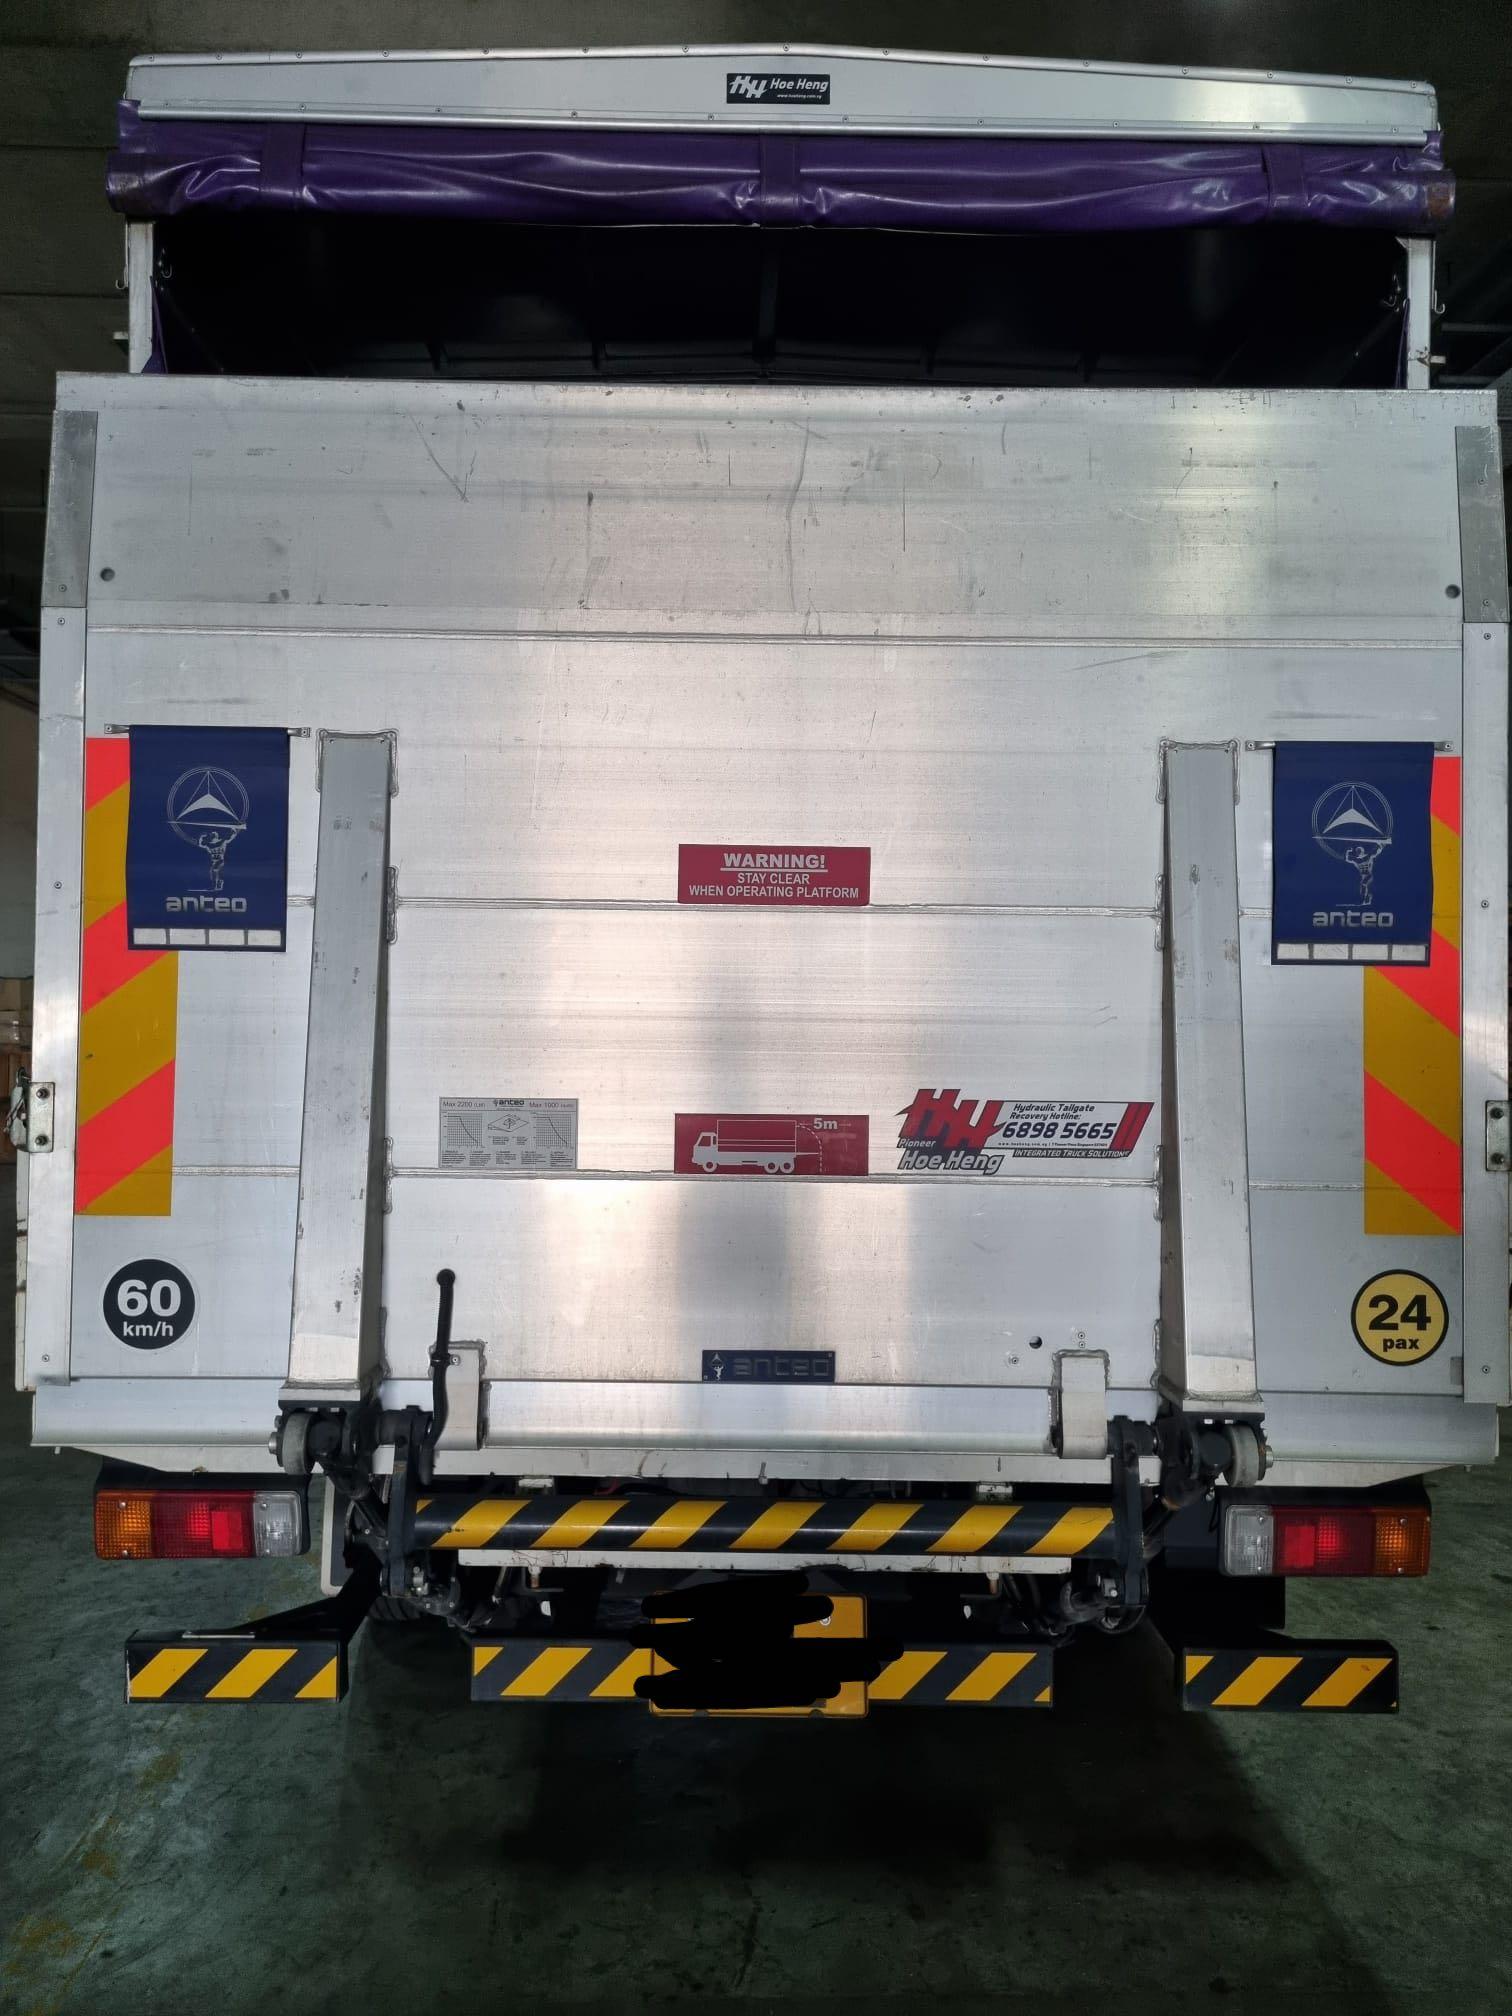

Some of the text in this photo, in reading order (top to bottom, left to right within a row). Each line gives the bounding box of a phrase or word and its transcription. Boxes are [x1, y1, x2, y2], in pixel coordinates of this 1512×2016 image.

[770, 78, 829, 93] Hoe Heng
[723, 853, 826, 869] WARNING!
[737, 872, 810, 885] STAY CLEAR
[689, 885, 859, 899] WHEN OPERATING PLATFORM
[166, 895, 247, 912] anteo
[1312, 910, 1394, 927] anteo
[1013, 1103, 1095, 1113] Hydraulic Tailgate
[813, 1118, 838, 1130] 5m
[1010, 1112, 1048, 1121] Recovery
[1002, 1121, 1117, 1140] 6898 5665
[899, 1138, 936, 1148] Pioneer
[1014, 1149, 1061, 1157] INTEGRATED
[1062, 1149, 1087, 1157] TRUCK
[898, 1150, 1004, 1175] Hoe Heng
[117, 1279, 181, 1317] 60
[1368, 1294, 1432, 1331] 24
[123, 1321, 174, 1337] km/h
[1382, 1338, 1420, 1352] pax
